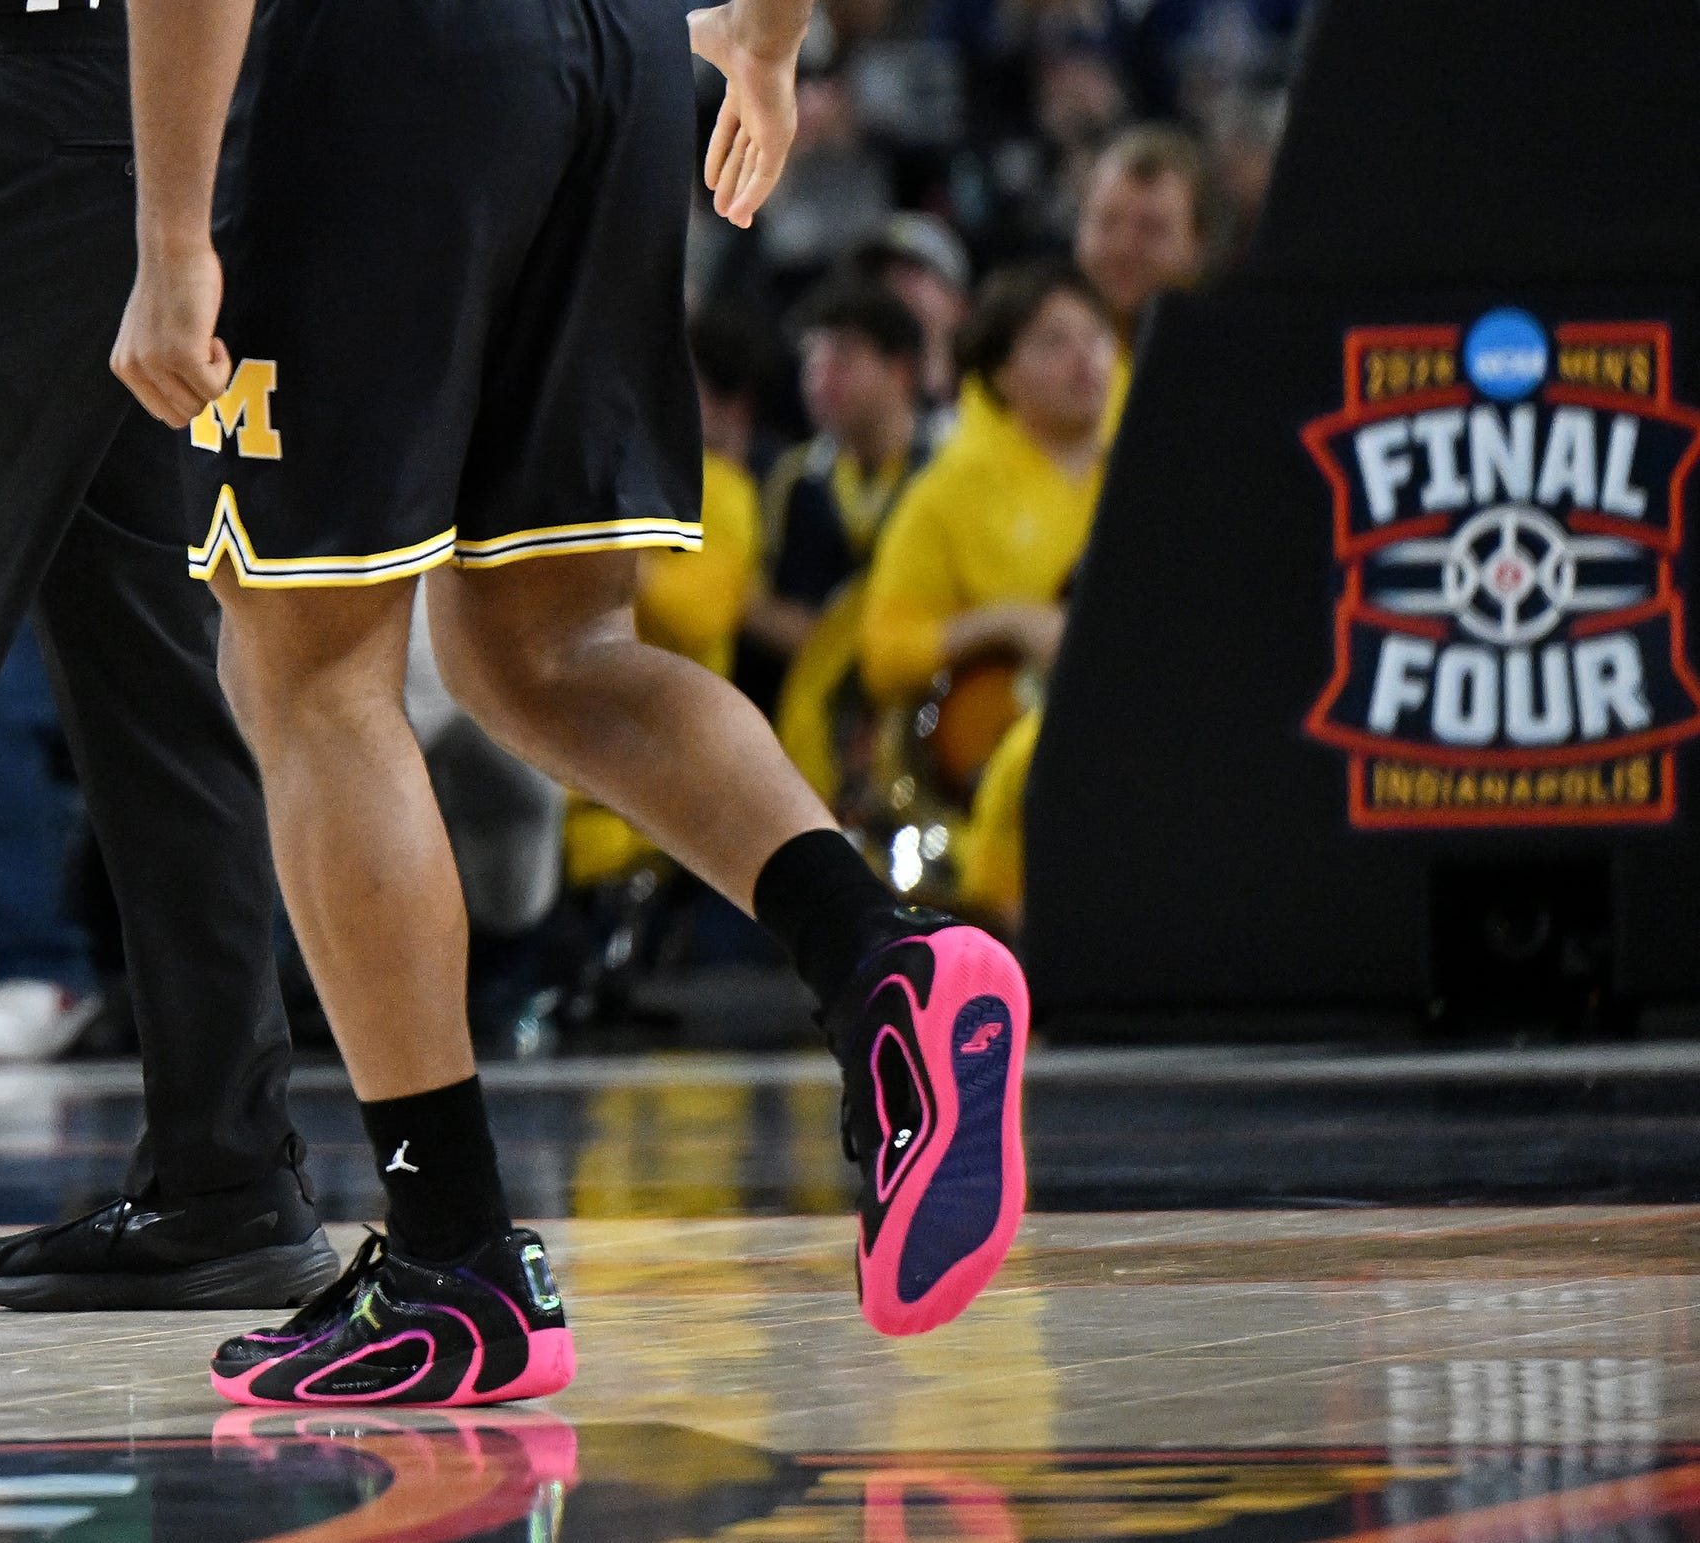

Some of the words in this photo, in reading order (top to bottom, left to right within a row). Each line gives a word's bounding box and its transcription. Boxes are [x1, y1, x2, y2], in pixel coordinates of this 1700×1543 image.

[189, 357, 284, 462] M
[1354, 402, 1648, 524] FINAL
[1367, 632, 1652, 747] FOUR
[1372, 756, 1651, 806] INDIANAPOLIS
